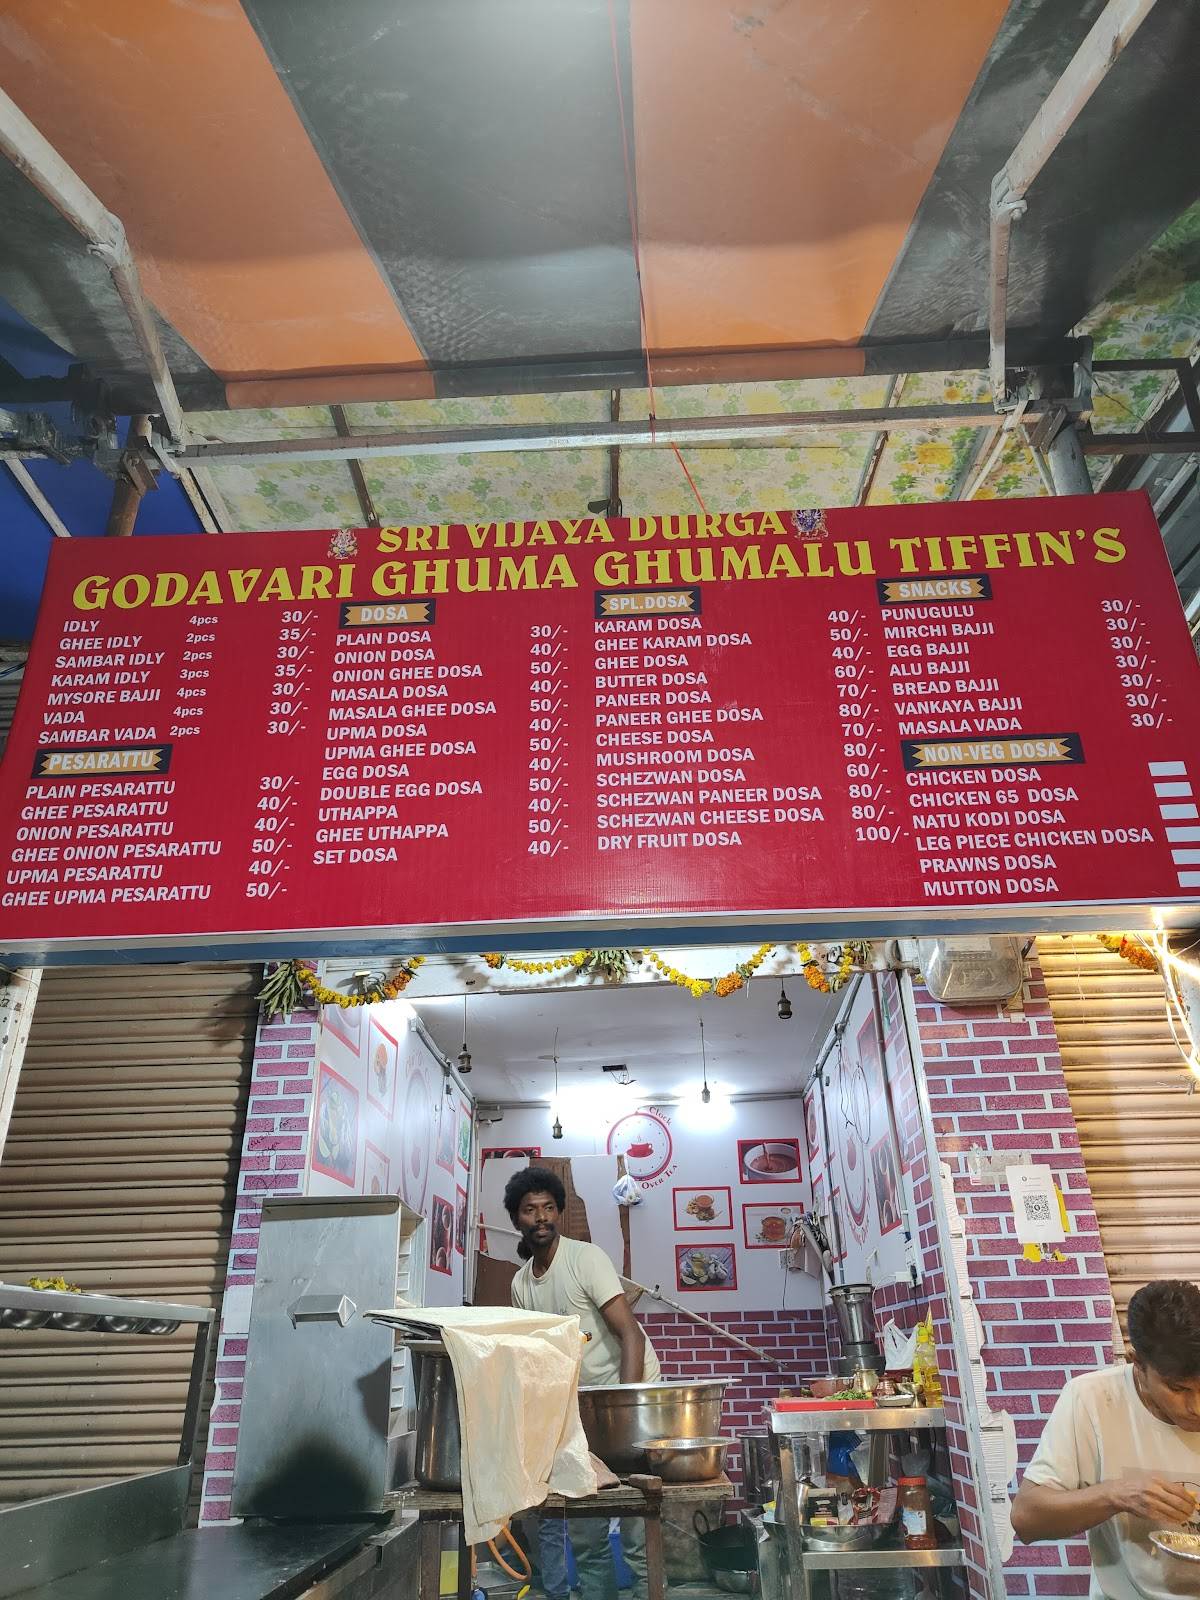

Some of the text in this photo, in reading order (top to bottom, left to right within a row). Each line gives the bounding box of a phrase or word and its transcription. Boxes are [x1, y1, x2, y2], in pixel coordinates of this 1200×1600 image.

[376, 511, 788, 553] SRI VIJAYA DURGA
[73, 528, 1126, 610] GODAVARI GHUMA GHUMALU TIFFIN'S
[899, 580, 972, 598] SNACKS
[609, 595, 688, 611] SPL.DOSA
[882, 600, 1140, 620] PUNUGULU 30/-
[361, 606, 408, 621] DOSA
[64, 616, 218, 632] IDLY 4pcs
[595, 617, 702, 633] KARAM DOSA
[884, 623, 994, 639] MIRCHI BAJJI
[60, 628, 316, 650] GHEE IDLY 2pcs 35/-
[336, 631, 431, 646] PLAIN DOSA
[595, 633, 752, 651] GHEE KARAM DOSA
[335, 643, 568, 664] ONION DOSA 40/-
[595, 647, 871, 669] GHEE DOSA 40/-
[887, 642, 969, 657] EGG BAJJI
[55, 651, 212, 668] SAMBAR IDLY 2pcs
[890, 661, 970, 676] ALU BAJJI
[52, 669, 209, 686] KARAM IDLY 3pcs
[333, 661, 568, 682] ONION GHEE DOSA 50/-
[596, 665, 873, 688] BUTTER DOSA 60/-
[48, 682, 310, 705] MYSORE BAJJI 4pcs 30/-
[331, 685, 448, 701] MASALA DOSA
[893, 674, 1161, 695] BREAD BAJJI 30/-
[596, 684, 876, 707] PANEER DOSA 70/-
[44, 707, 203, 724] VADA 4pcs
[329, 702, 496, 720] MASALA GHEE DOSA
[895, 698, 1023, 717] VANKAYA BAJJI
[596, 708, 763, 727] PANEER GHEE DOSA
[899, 717, 1023, 735] MASALA VADA
[39, 726, 200, 744] SAMBAR VADA 2pcs
[327, 724, 427, 740] UPMA DOSA
[596, 730, 714, 746] CHEESE DOSA
[325, 741, 476, 760] UPMA GHEE DOSA
[597, 743, 885, 766] MUSHROOM DOSA 80/-
[924, 741, 1061, 763] NON-VEG DOSA
[49, 751, 154, 770] PESARATTU
[323, 757, 568, 780] EGG DOSA 40/-
[597, 768, 746, 787] SCHEZWAN DOSA
[906, 768, 1041, 786] CHICKEN DOSA
[26, 776, 299, 799] PLAIN PESARATTU 30/-
[321, 781, 482, 800] DOUBLE EGG DOSA
[597, 784, 890, 807] SCHEZWAN PANEER DOSA 80/-
[910, 787, 1079, 807] CHICKEN 65 DOSA
[21, 801, 168, 820] GHEE PESARATTU
[319, 805, 398, 821] UTHAPPA
[597, 808, 824, 828] SCHEZWAN CHEESE DOSA
[913, 810, 1065, 829] NATU KODI DOSA
[17, 822, 173, 840] ONION PESARATTU
[316, 824, 448, 842] GHEE UTHAPPA
[598, 826, 909, 852] DRY FRUIT DOSA 100/-
[916, 828, 1154, 851] LEG PIECE CHICKEN DOSA
[12, 838, 292, 862] GHEE ONION PESARATTU 50/-
[313, 840, 568, 864] SET DOSA 40/-
[920, 854, 1056, 873] PRAWNS DOSA
[7, 865, 162, 884] UPMA PESARATTU
[2, 885, 211, 906] GHEE UPMA PESARATTU
[924, 877, 1059, 896] MUTTON DOSA
